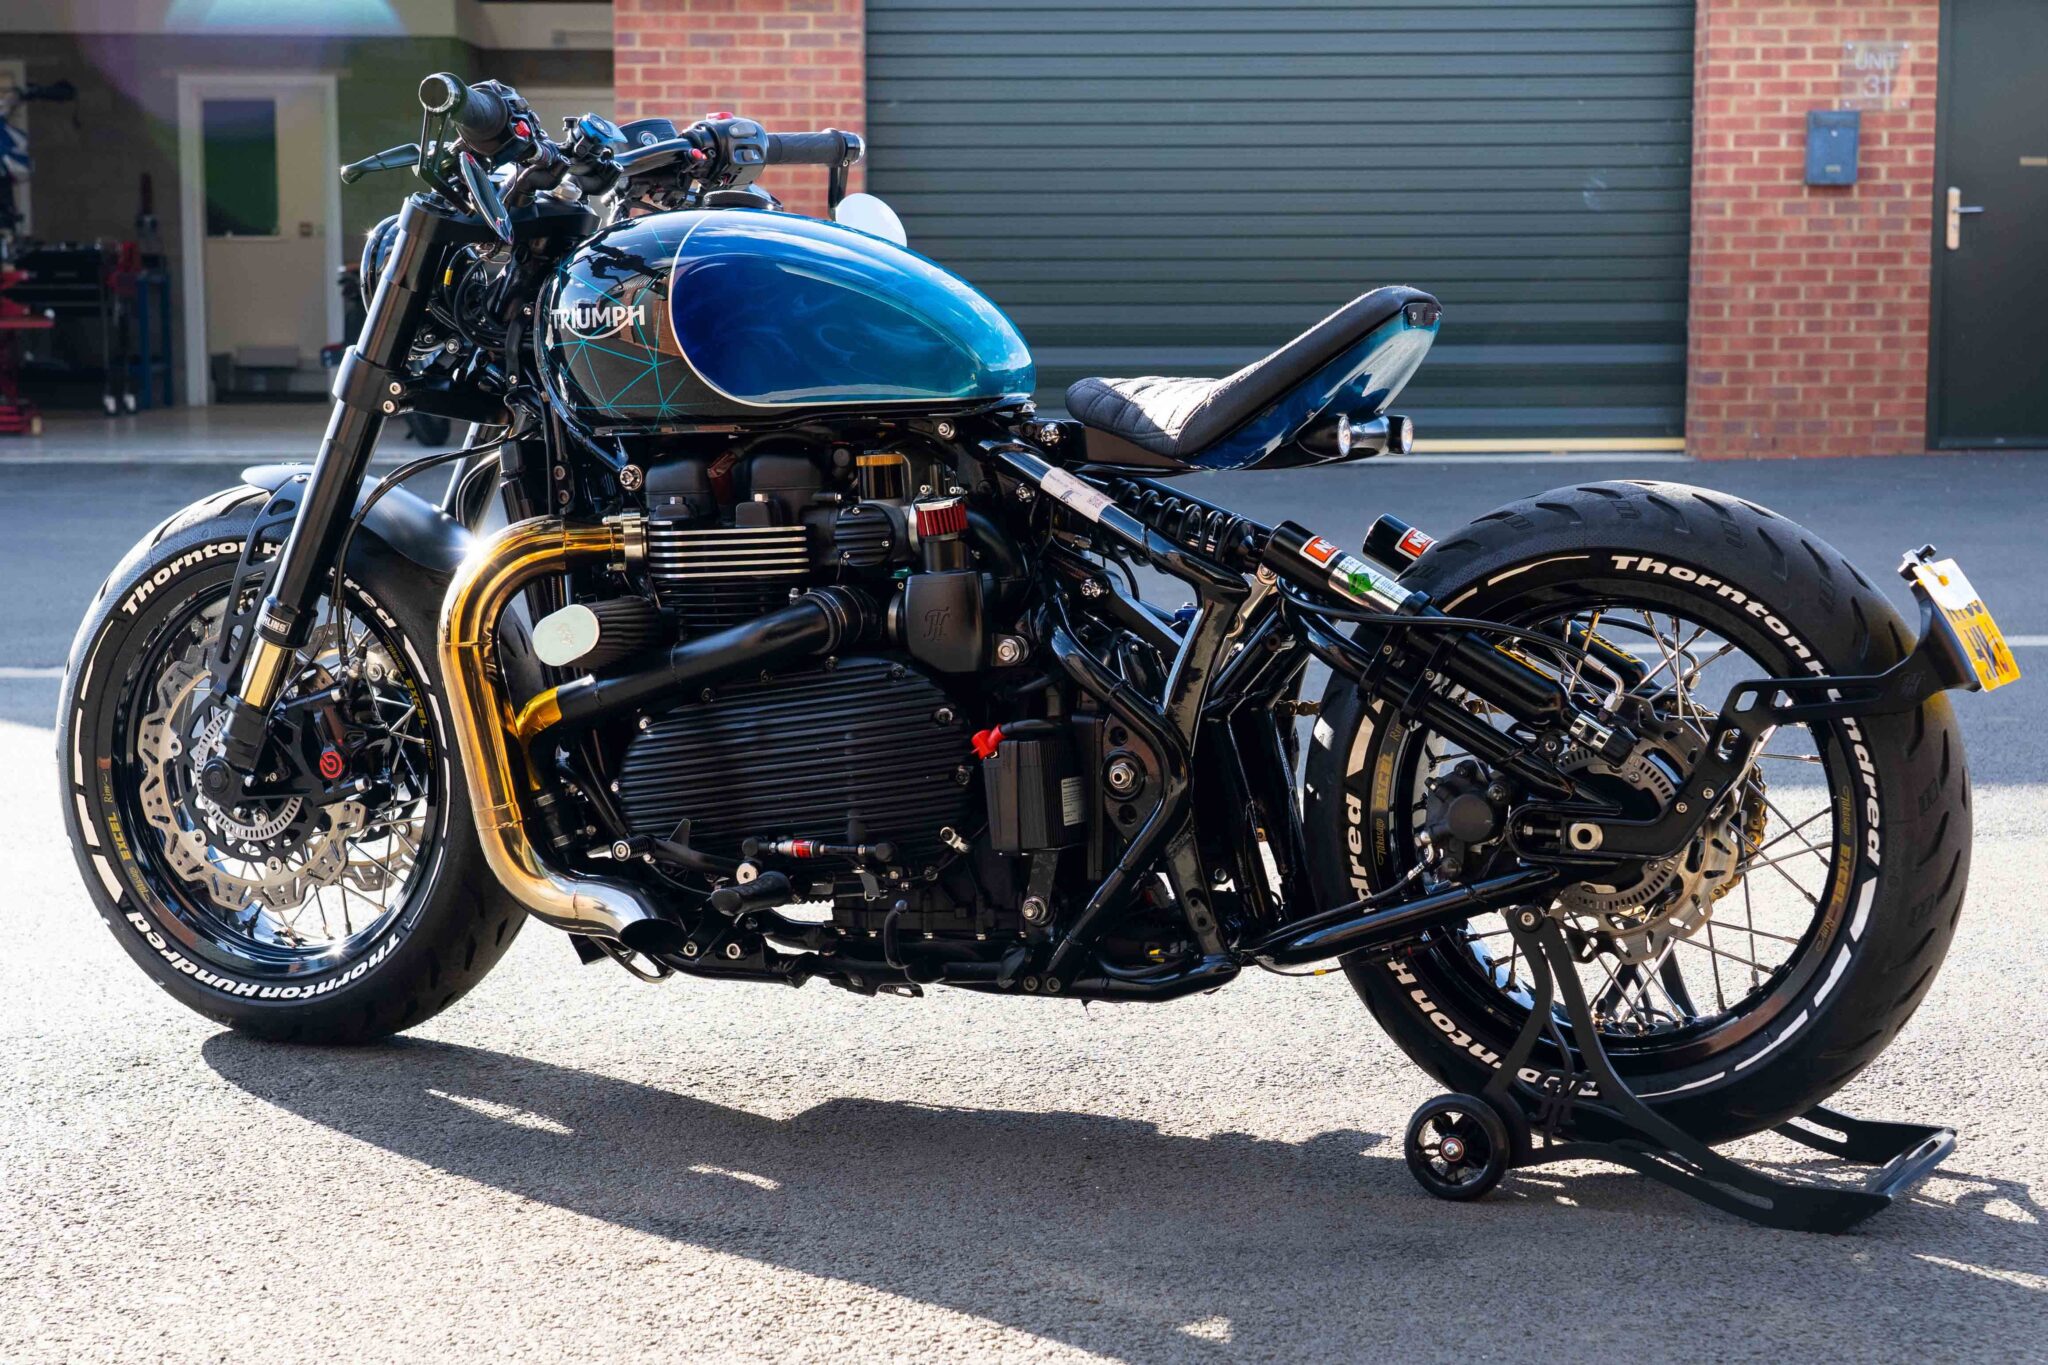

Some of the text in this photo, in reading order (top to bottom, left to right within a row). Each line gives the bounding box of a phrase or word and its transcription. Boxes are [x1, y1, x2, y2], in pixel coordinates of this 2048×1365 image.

[1854, 51, 1898, 70] UNIT
[1863, 75, 1891, 97] 31
[551, 305, 646, 329] TRIUMPH
[404, 677, 428, 729] EXCEL
[108, 811, 132, 861] EXCEL
[1831, 843, 1851, 904] EXCEL
